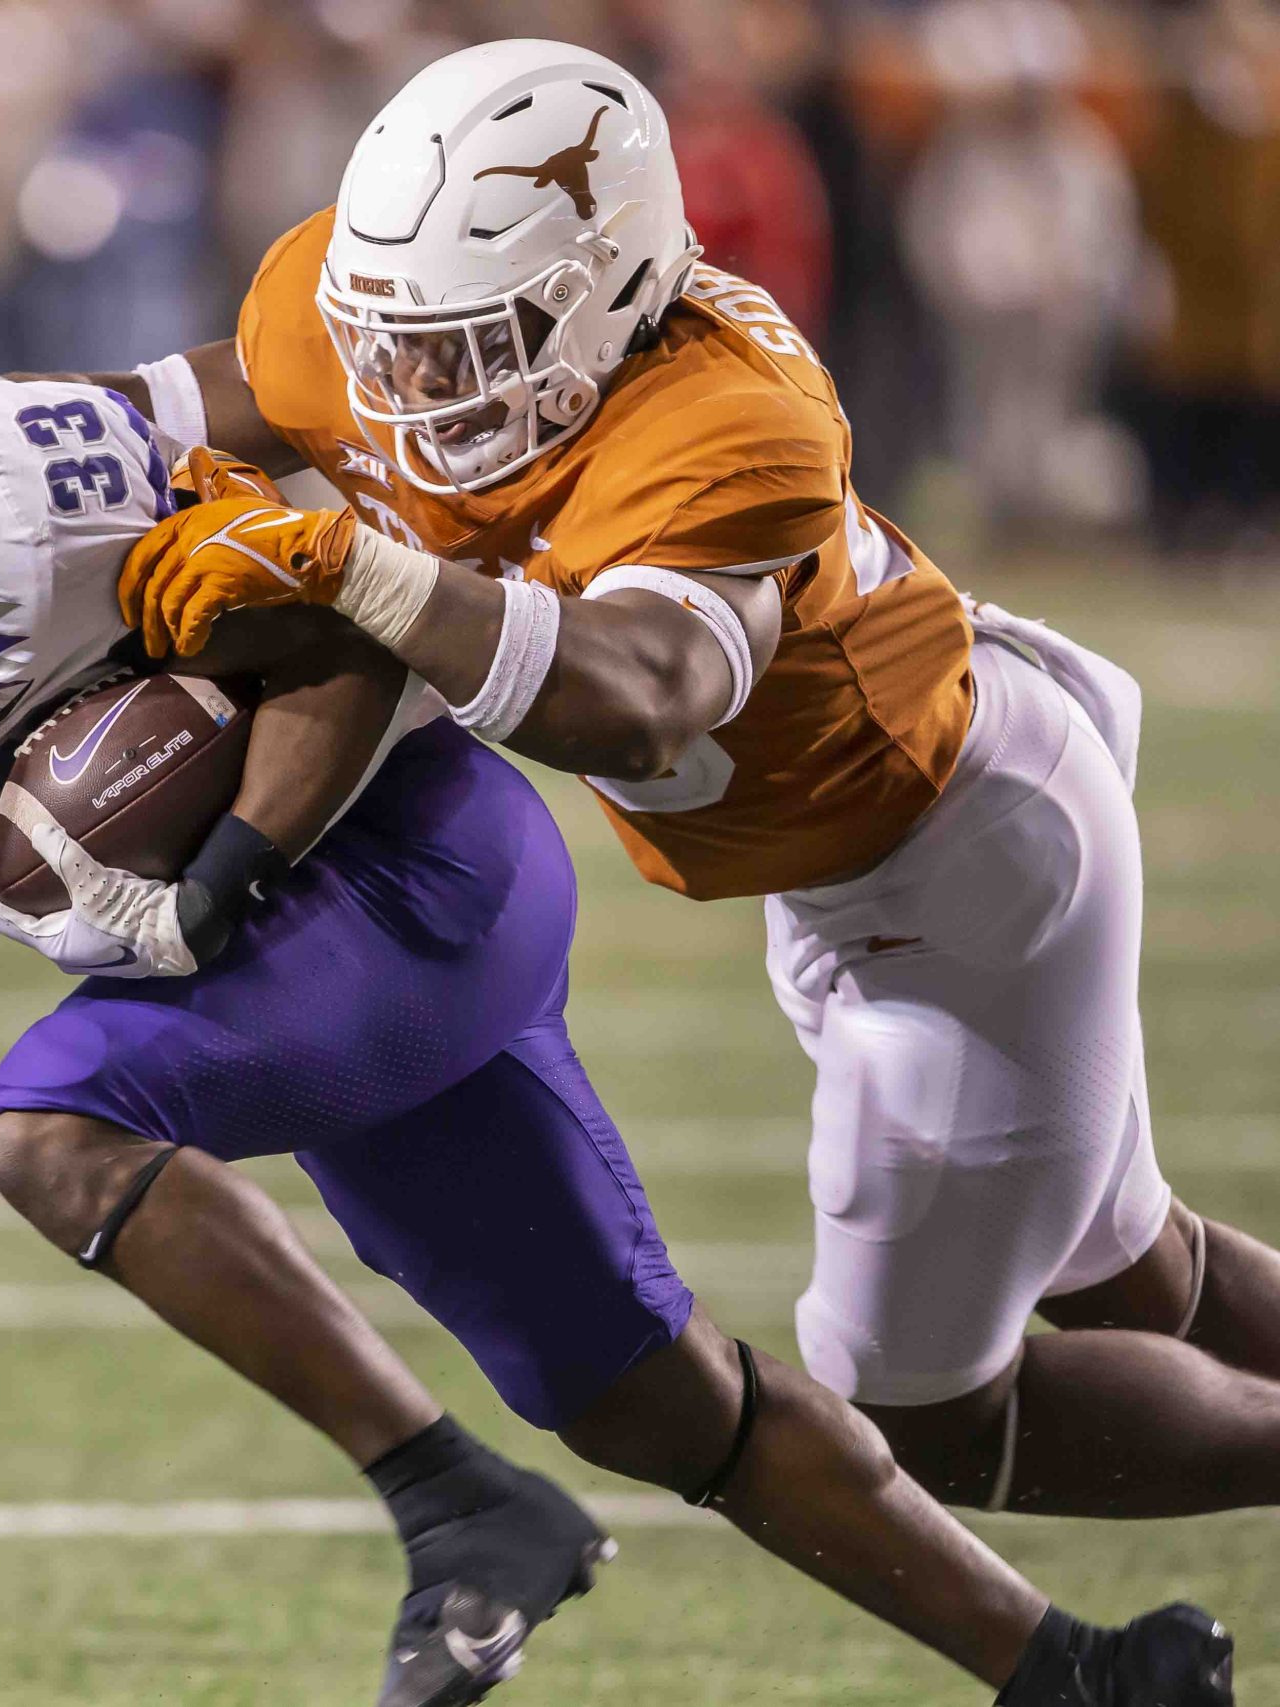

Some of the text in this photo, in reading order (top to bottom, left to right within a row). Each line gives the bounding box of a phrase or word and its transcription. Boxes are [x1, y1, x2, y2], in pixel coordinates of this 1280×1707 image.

[15, 399, 132, 517] 33
[92, 729, 194, 809] VAPOR ELITE
